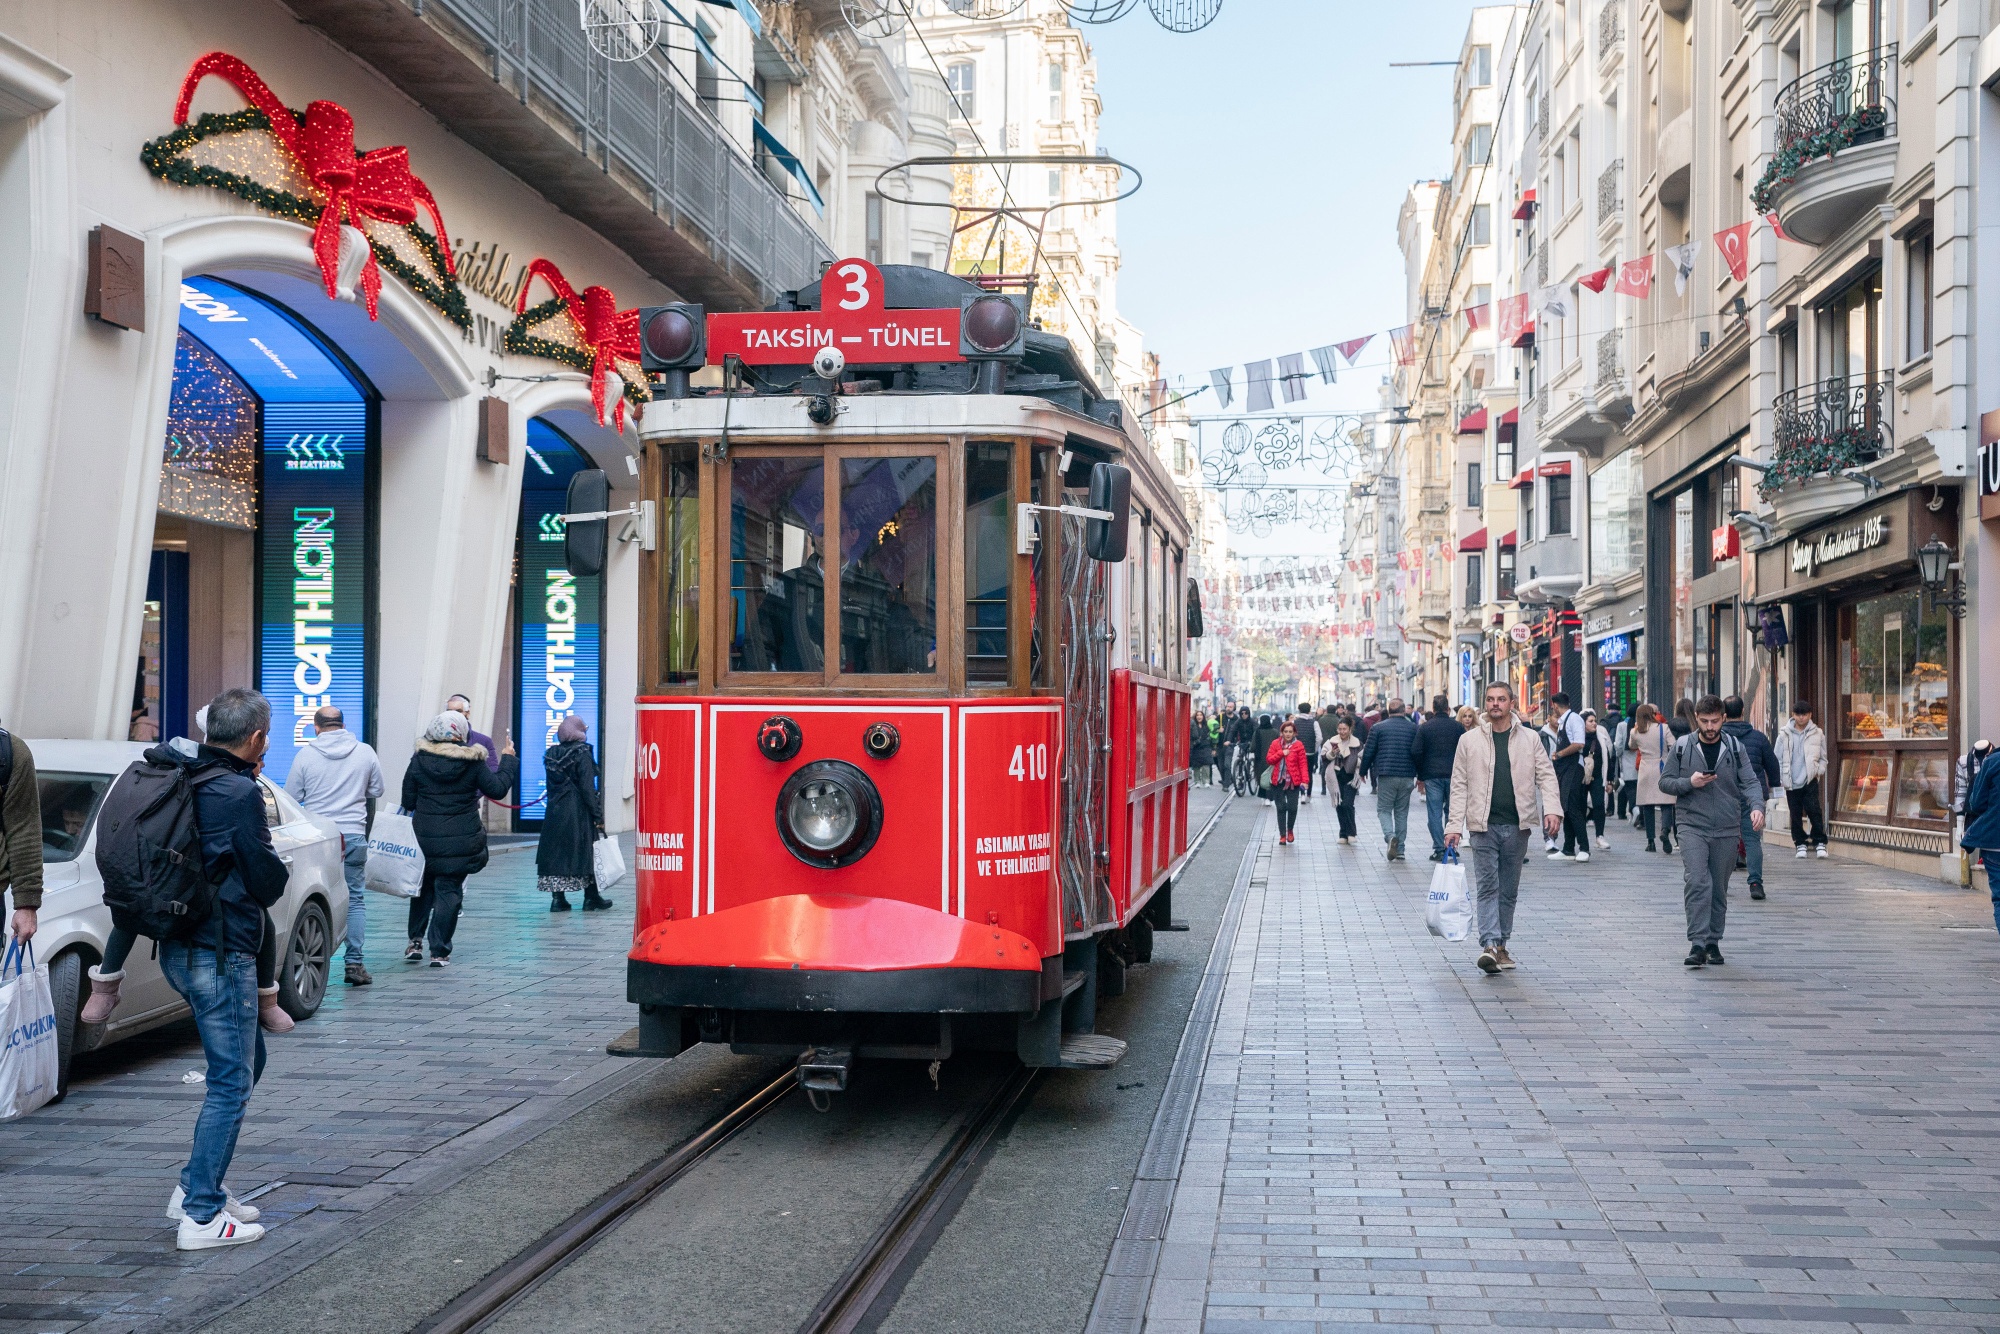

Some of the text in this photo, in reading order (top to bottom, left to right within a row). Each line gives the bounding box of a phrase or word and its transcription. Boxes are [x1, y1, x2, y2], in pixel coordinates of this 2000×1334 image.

[837, 264, 869, 310] 3
[742, 323, 834, 347] TAKSİM
[868, 322, 950, 346] TÜNEL
[1863, 514, 1882, 550] 1935
[294, 507, 334, 746] DECATHLON
[638, 742, 660, 780] 410
[1008, 743, 1047, 781] 410
[653, 833, 684, 849] YASAK
[976, 835, 1026, 854] ASILMAK
[977, 859, 991, 876] VE
